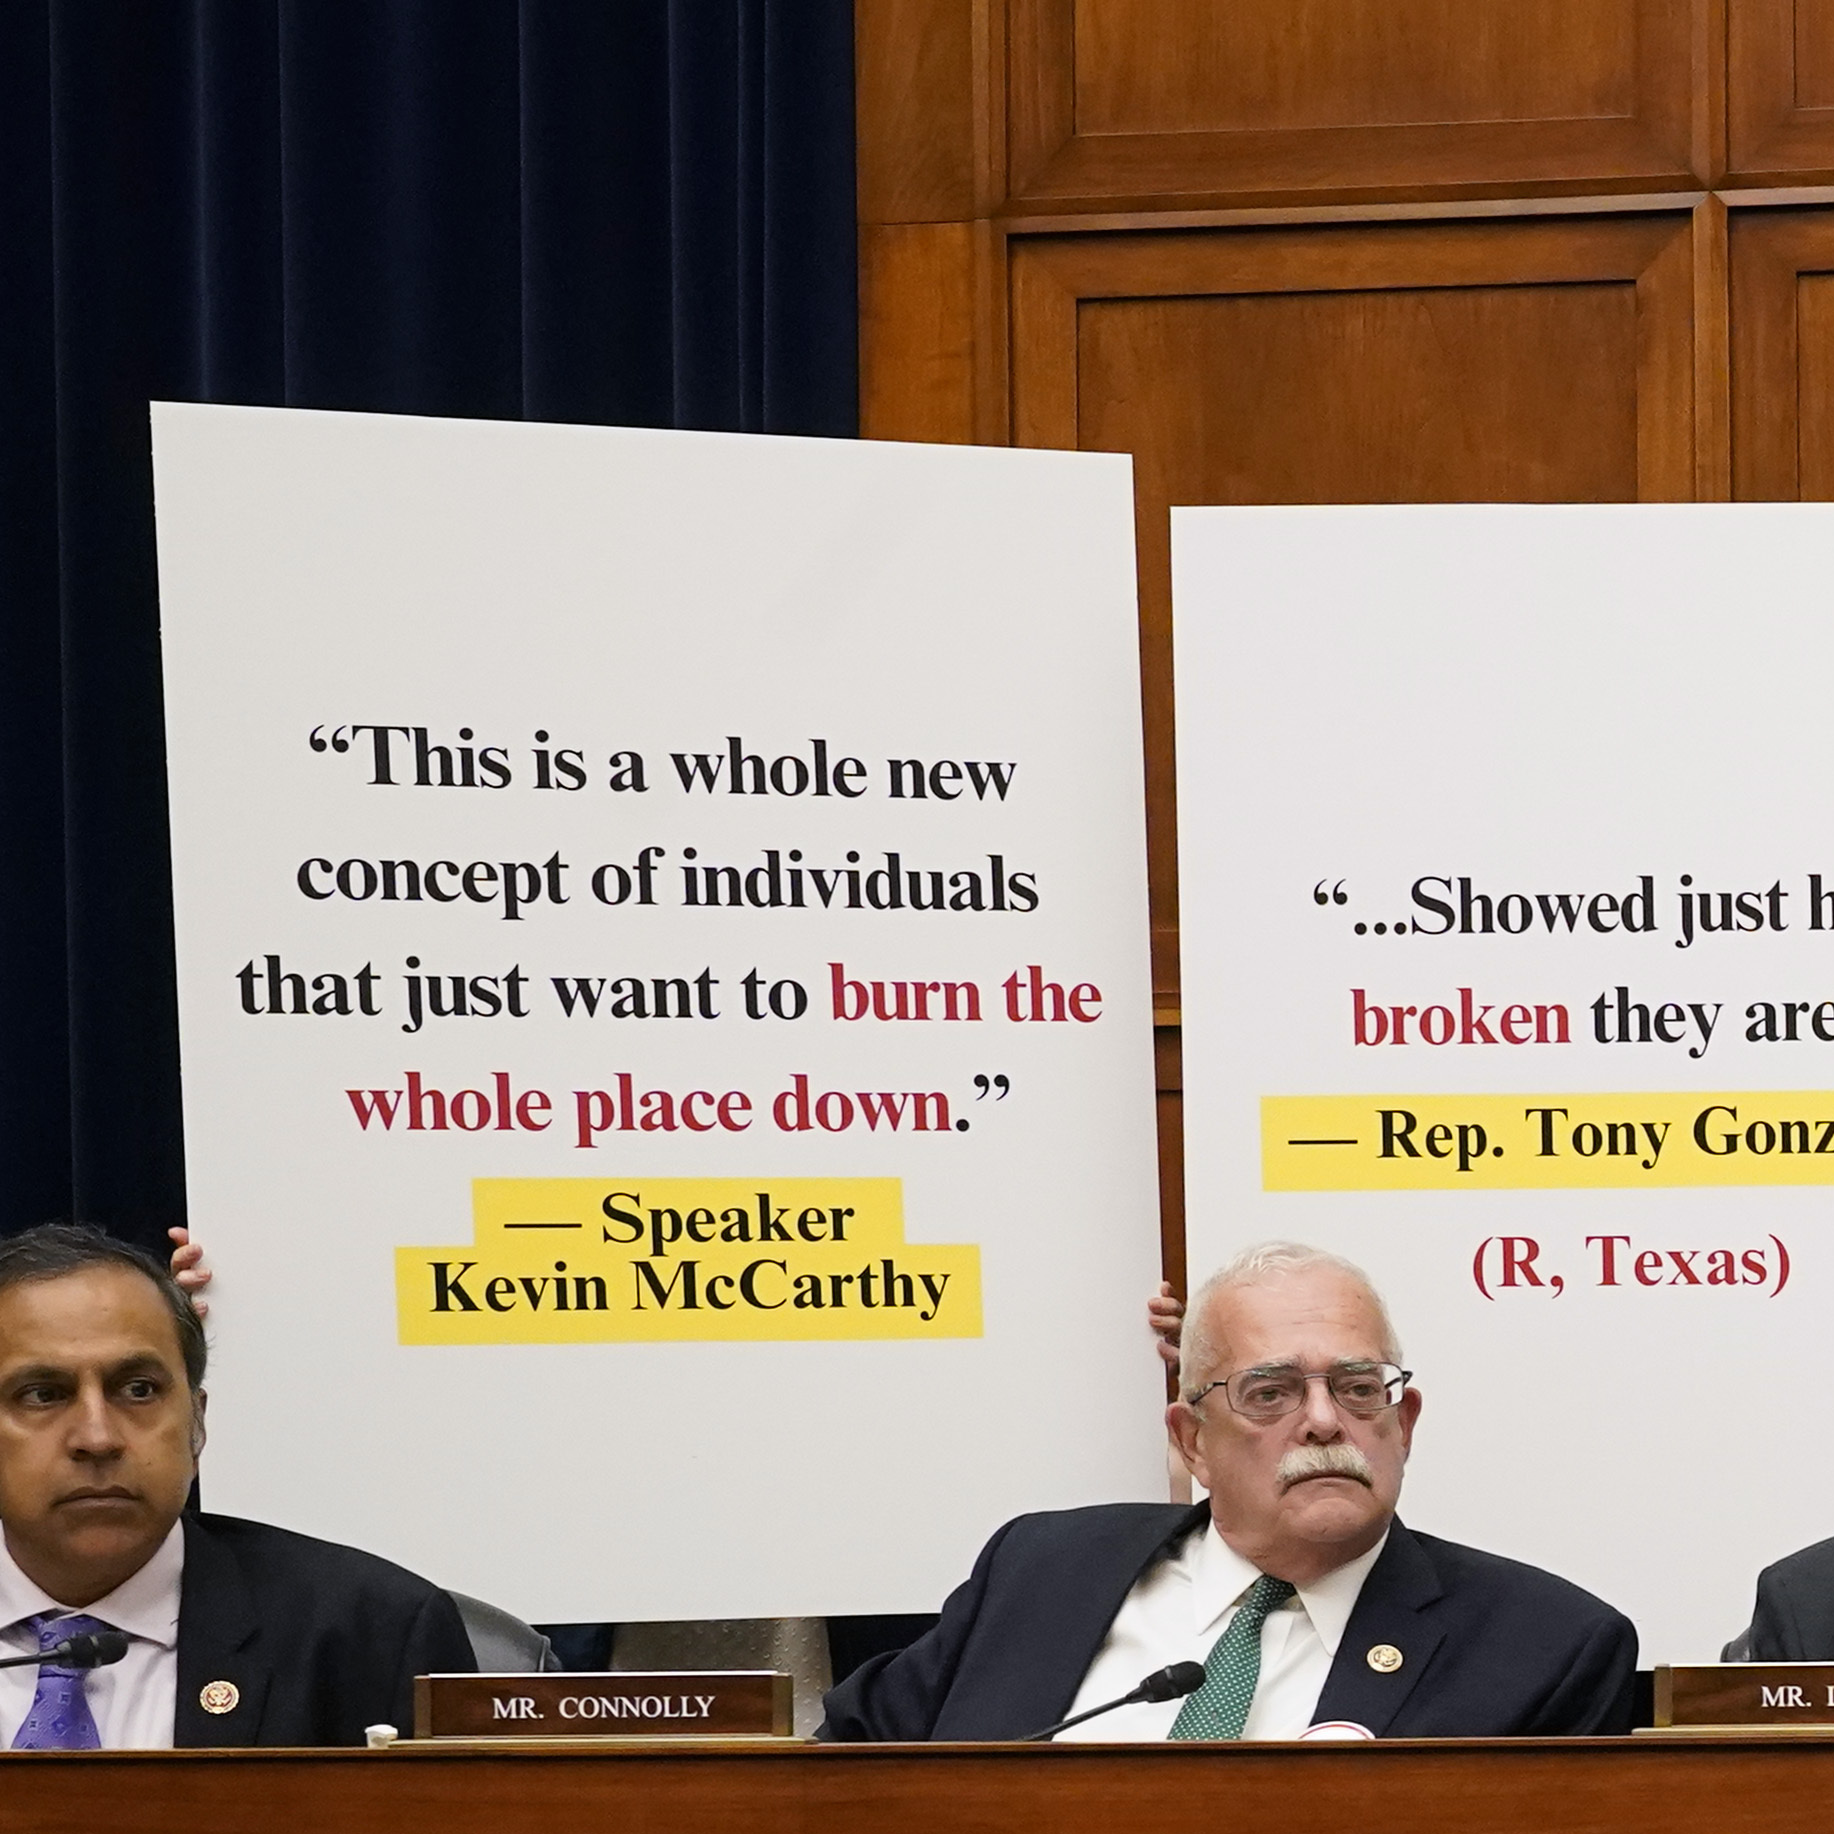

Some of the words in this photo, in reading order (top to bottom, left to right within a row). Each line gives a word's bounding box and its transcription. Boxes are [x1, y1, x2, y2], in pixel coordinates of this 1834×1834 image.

[310, 725, 511, 789] “This
[532, 730, 586, 791] is
[609, 751, 649, 792] a
[670, 737, 867, 797] whole
[887, 760, 1016, 801] new
[297, 851, 570, 920] concept
[592, 847, 665, 905] of
[681, 847, 1038, 912] individuals
[1675, 875, 1788, 948] just
[236, 955, 382, 1016] that
[402, 956, 529, 1033] just
[551, 967, 720, 1019] want
[741, 968, 807, 1020] to
[828, 963, 982, 1021] burn
[1002, 966, 1102, 1022] the
[1351, 988, 1571, 1046] broken
[1590, 987, 1723, 1058] they
[346, 1072, 552, 1131] whole
[573, 1073, 752, 1148] place
[773, 1074, 1009, 1132] down.”
[1377, 1110, 1503, 1171] Rep.
[1526, 1109, 1671, 1169] Tony
[603, 1193, 854, 1257] Speaker
[428, 1261, 609, 1312] Kevin
[630, 1260, 950, 1321] McCarthy
[1473, 1237, 1563, 1300] (R,
[1586, 1234, 1789, 1297] Texas)
[492, 1698, 543, 1719] MR.
[558, 1696, 715, 1718] CONNOLLY
[1761, 1686, 1811, 1708] MR.
